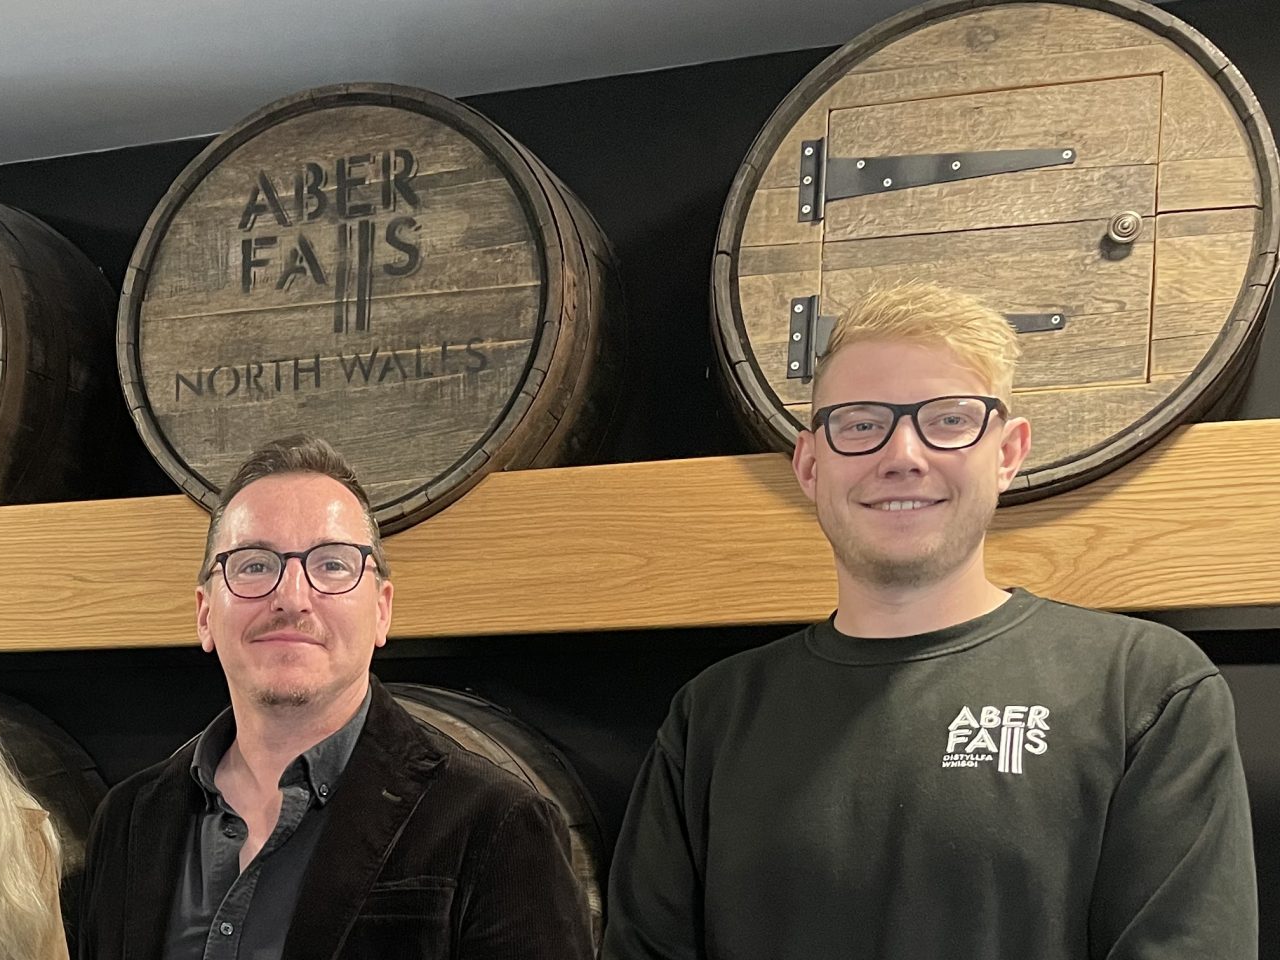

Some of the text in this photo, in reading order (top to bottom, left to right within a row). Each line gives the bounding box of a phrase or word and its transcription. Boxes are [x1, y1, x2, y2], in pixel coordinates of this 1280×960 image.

[237, 148, 421, 231] ABER
[175, 336, 489, 402] NORTH WALES
[947, 705, 1051, 731] ABER
[942, 753, 994, 762] DISTYLLFA
